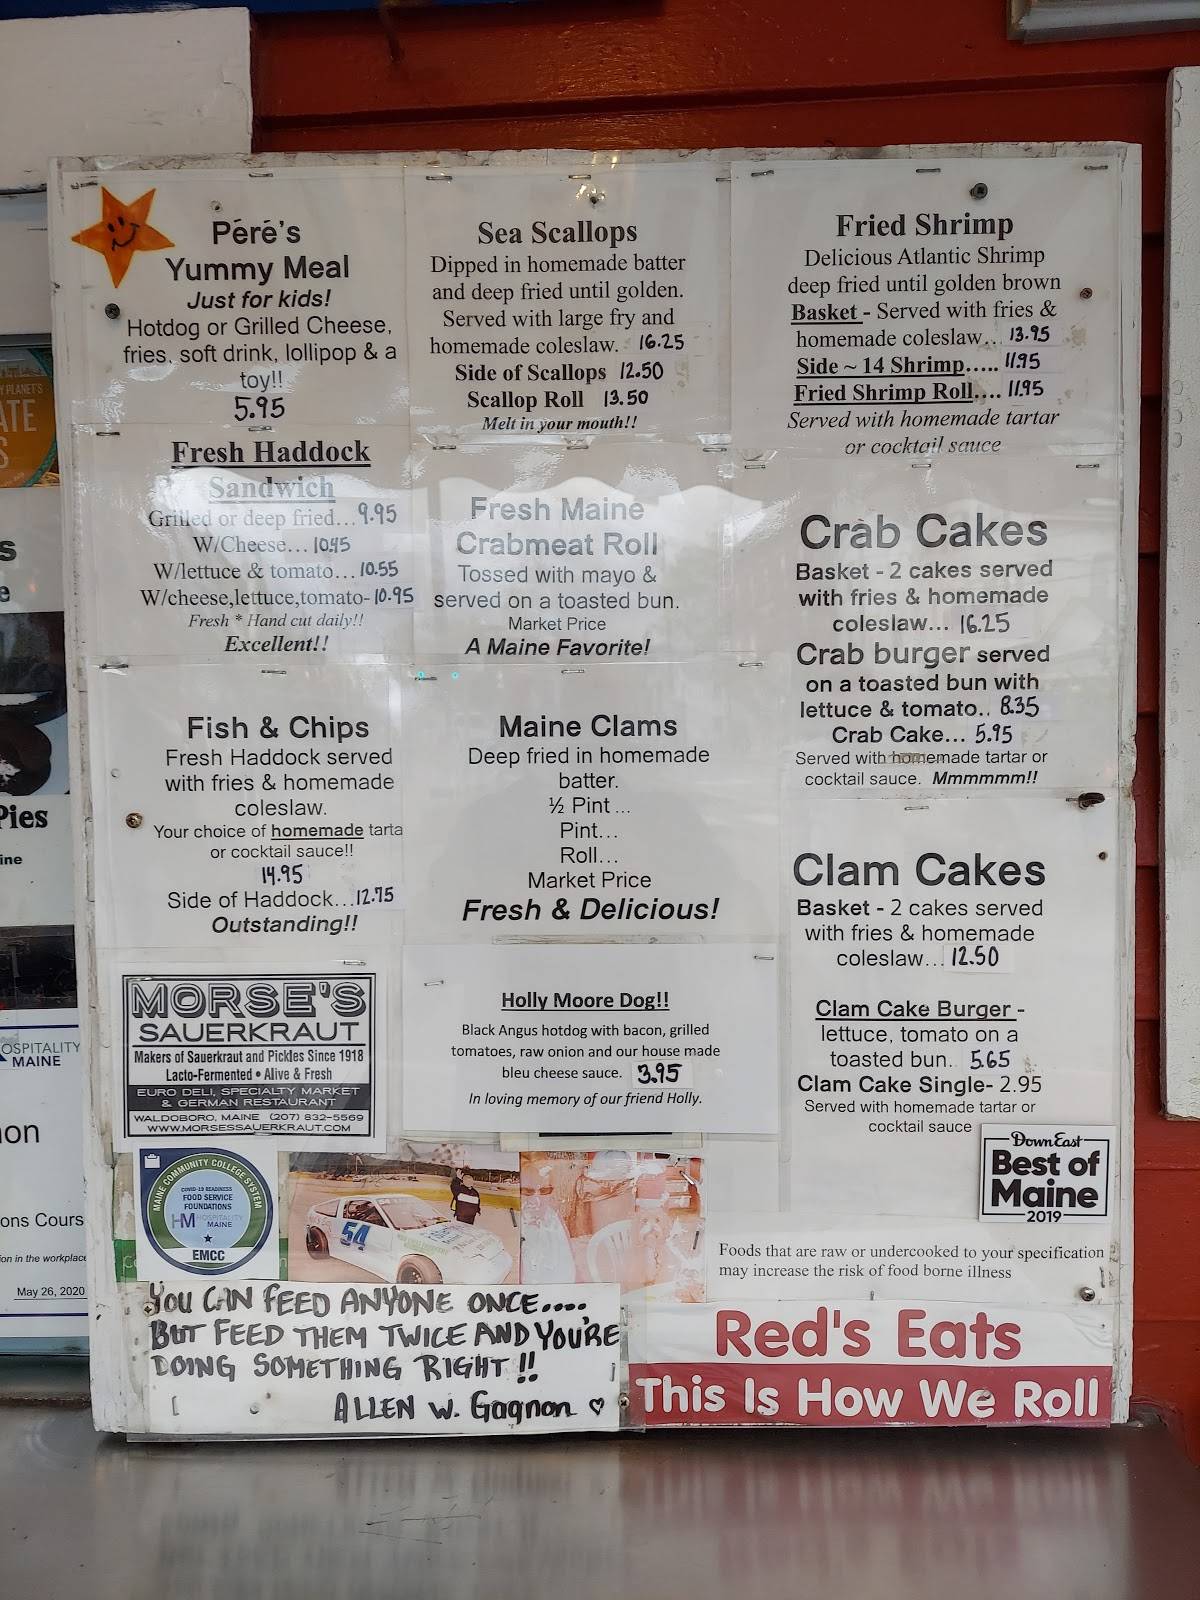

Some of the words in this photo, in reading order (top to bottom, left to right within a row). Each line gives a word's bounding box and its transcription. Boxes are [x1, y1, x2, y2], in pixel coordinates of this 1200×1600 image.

[478, 222, 522, 244] Sea
[532, 220, 637, 247] Scallops
[836, 214, 906, 237] Fried
[915, 213, 1013, 240] Shrimp
[804, 249, 892, 266] Delicious
[897, 247, 971, 264] Atlantic
[977, 246, 1045, 266] Shrimp
[165, 257, 274, 285] Yummy
[284, 255, 350, 279] Meal
[187, 291, 234, 310] Just
[241, 291, 271, 308] for
[279, 289, 331, 307] kids!
[430, 337, 530, 354] homemade
[536, 335, 619, 354] coleslaw.
[640, 333, 684, 350] 16.25
[234, 396, 285, 421] 5.95
[788, 410, 851, 428] Served
[856, 411, 894, 427] with
[900, 410, 1000, 427] homemade
[1005, 411, 1060, 425] tartar
[482, 417, 517, 431] Melt
[520, 417, 534, 430] in
[538, 418, 573, 433] your
[577, 416, 637, 430] mouth!!
[172, 441, 245, 463] Fresh
[254, 441, 371, 463] Haddock
[208, 475, 335, 498] Sandwich
[800, 514, 900, 549] Crab
[916, 512, 1048, 548] Cakes
[456, 531, 594, 556] Crabmeat
[604, 532, 658, 555] Roll
[188, 614, 229, 628] Fresh
[247, 614, 286, 627] Hand
[290, 615, 312, 627] cut
[317, 613, 364, 629] daily!!
[509, 617, 562, 631] Market
[567, 617, 606, 630] Price
[224, 635, 329, 652] Excellent!!
[188, 716, 249, 739] Fish
[260, 716, 279, 738] &
[289, 716, 369, 743] Chips
[500, 715, 582, 738] Maine
[592, 714, 678, 736] Clams
[796, 752, 850, 765] Served
[856, 752, 885, 764] with
[892, 752, 979, 764] homemade
[986, 752, 1026, 763] tartar
[1032, 752, 1048, 763] or
[154, 825, 188, 839] Your
[194, 826, 246, 838] choice
[251, 824, 266, 837] of
[271, 824, 364, 839] homemade
[262, 864, 303, 885] 14.95
[794, 853, 899, 886] Clam
[916, 853, 1046, 886] Cakes
[462, 899, 541, 920] Fresh
[552, 898, 570, 920] &
[580, 898, 720, 920] Delicious!
[132, 982, 366, 1018] MORSE'S
[502, 992, 548, 1011] Holly
[554, 992, 614, 1008] Moore
[620, 992, 670, 1011] Dog!!
[139, 1022, 359, 1042] SAUERKRAUT
[12, 1056, 61, 1067] MAINE
[134, 1052, 171, 1063] Makers
[175, 1051, 184, 1063] of
[187, 1051, 242, 1063] Sauerkraut
[246, 1051, 264, 1062] and
[268, 1050, 304, 1062] Pickles
[308, 1050, 335, 1062] Since
[339, 1050, 363, 1061] 1918
[166, 1069, 252, 1081] Lacto-Fermented
[265, 1068, 290, 1080] Alive
[293, 1068, 301, 1080] &
[305, 1068, 332, 1080] Fresh
[502, 1067, 530, 1079] bleu
[534, 1067, 578, 1079] cheese
[582, 1069, 622, 1079] sauce.
[637, 1063, 682, 1084] 3.95
[137, 1089, 176, 1097] EURO
[182, 1088, 216, 1097] DELI,
[221, 1088, 296, 1096] SPECIALTY
[302, 1087, 360, 1096] MARKET
[798, 1075, 850, 1093] Clam
[859, 1075, 911, 1093] Cake
[919, 1075, 993, 1096] Single-
[999, 1075, 1042, 1093] 2.95
[178, 1099, 238, 1107] GERMAN
[244, 1098, 336, 1107] RESTAURANT
[469, 1093, 480, 1104] In
[485, 1093, 523, 1106] loving
[527, 1095, 579, 1106] memory
[584, 1093, 597, 1104] of
[600, 1095, 622, 1104] our
[625, 1092, 663, 1106] friend
[667, 1092, 702, 1106] Holly.
[269, 1113, 299, 1121] (207)
[868, 1120, 924, 1133] cocktail
[929, 1122, 972, 1133] sauce
[147, 1124, 351, 1133] WWW.MORSESSAUERKRAUT.COM
[992, 1150, 1060, 1176] Best
[1068, 1150, 1100, 1176] of
[153, 1186, 166, 1211] MAINE
[163, 1159, 209, 1185] COMMUNITY
[212, 1159, 246, 1179] COLLEGE
[244, 1177, 262, 1209] SYSTEM
[992, 1178, 1098, 1208] Maine
[1027, 1211, 1062, 1222] 2019
[15, 1255, 23, 1263] in
[193, 1250, 225, 1261] EMCC
[719, 1243, 762, 1258] Foods
[765, 1244, 792, 1258] that
[796, 1247, 818, 1258] are
[821, 1247, 847, 1259] raw
[851, 1248, 865, 1259] or
[870, 1244, 959, 1259] undercooked
[963, 1246, 977, 1259] to
[981, 1248, 1014, 1262] your
[1018, 1245, 1104, 1262] specification
[17, 1287, 38, 1297] May
[42, 1287, 56, 1298] 26,
[60, 1286, 85, 1296] 2020
[148, 1281, 193, 1315] YOU
[203, 1287, 253, 1313] CAN
[340, 1286, 453, 1316] ANYONE
[716, 1306, 871, 1358] Red's
[897, 1308, 1021, 1360] Eats
[636, 1375, 726, 1414] This
[744, 1377, 780, 1416] Is
[798, 1378, 904, 1418] How
[919, 1379, 996, 1418] We
[1014, 1378, 1098, 1418] Roll
[334, 1392, 414, 1422] ALLEN
[471, 1390, 577, 1425] Gagnon
